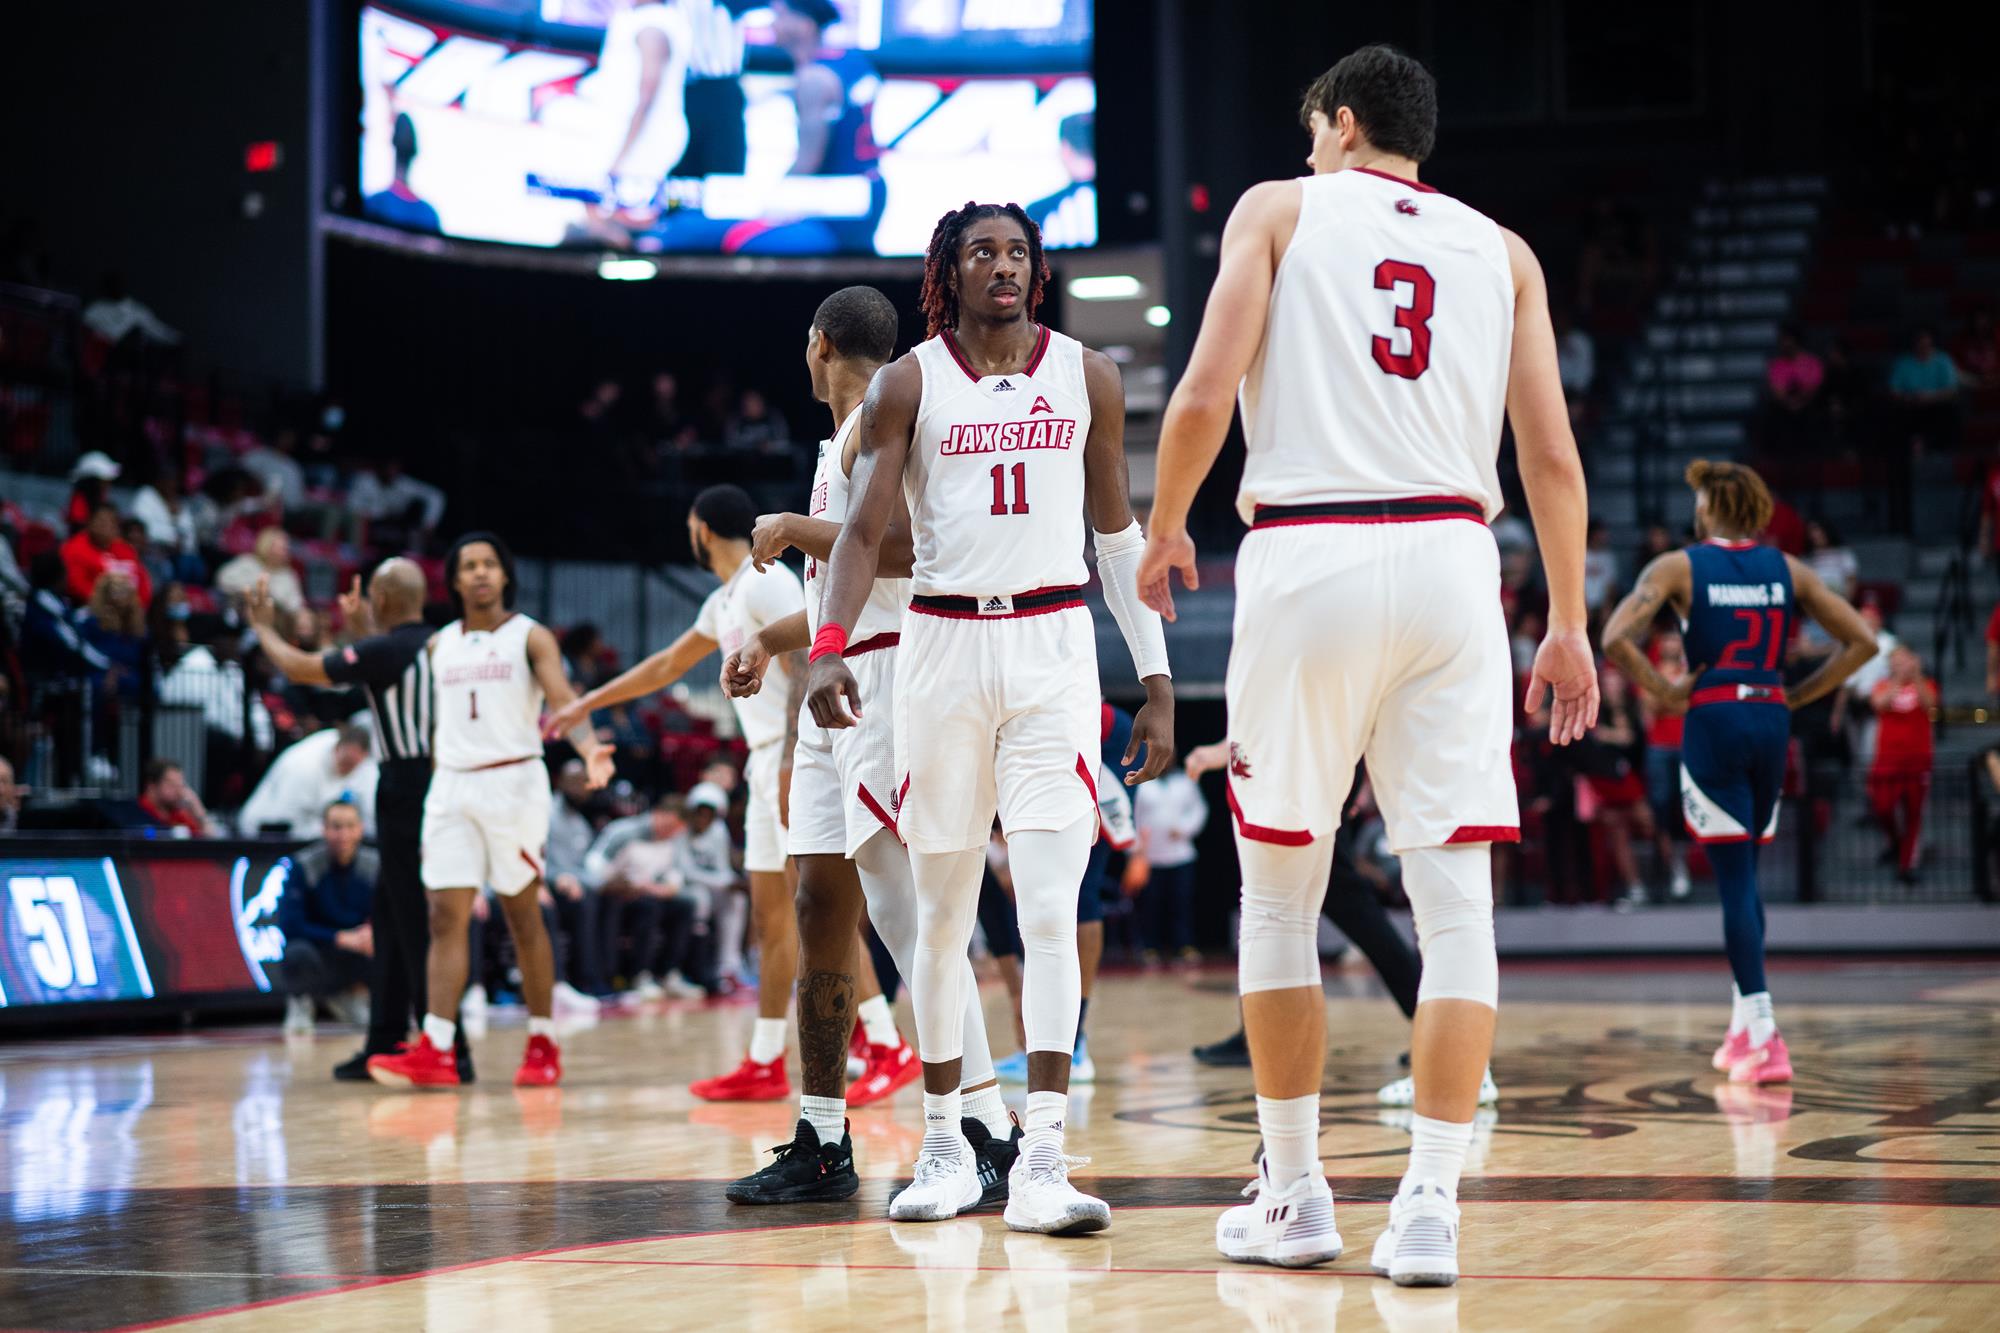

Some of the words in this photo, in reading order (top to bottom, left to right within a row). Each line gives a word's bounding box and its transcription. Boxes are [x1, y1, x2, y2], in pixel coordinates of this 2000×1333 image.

[1371, 258, 1436, 381] 3
[940, 423, 999, 456] JAX
[1000, 418, 1076, 451] STATE
[990, 461, 1030, 516] 11
[1715, 608, 1785, 671] 21
[469, 691, 479, 720] 1
[8, 876, 98, 989] 57
